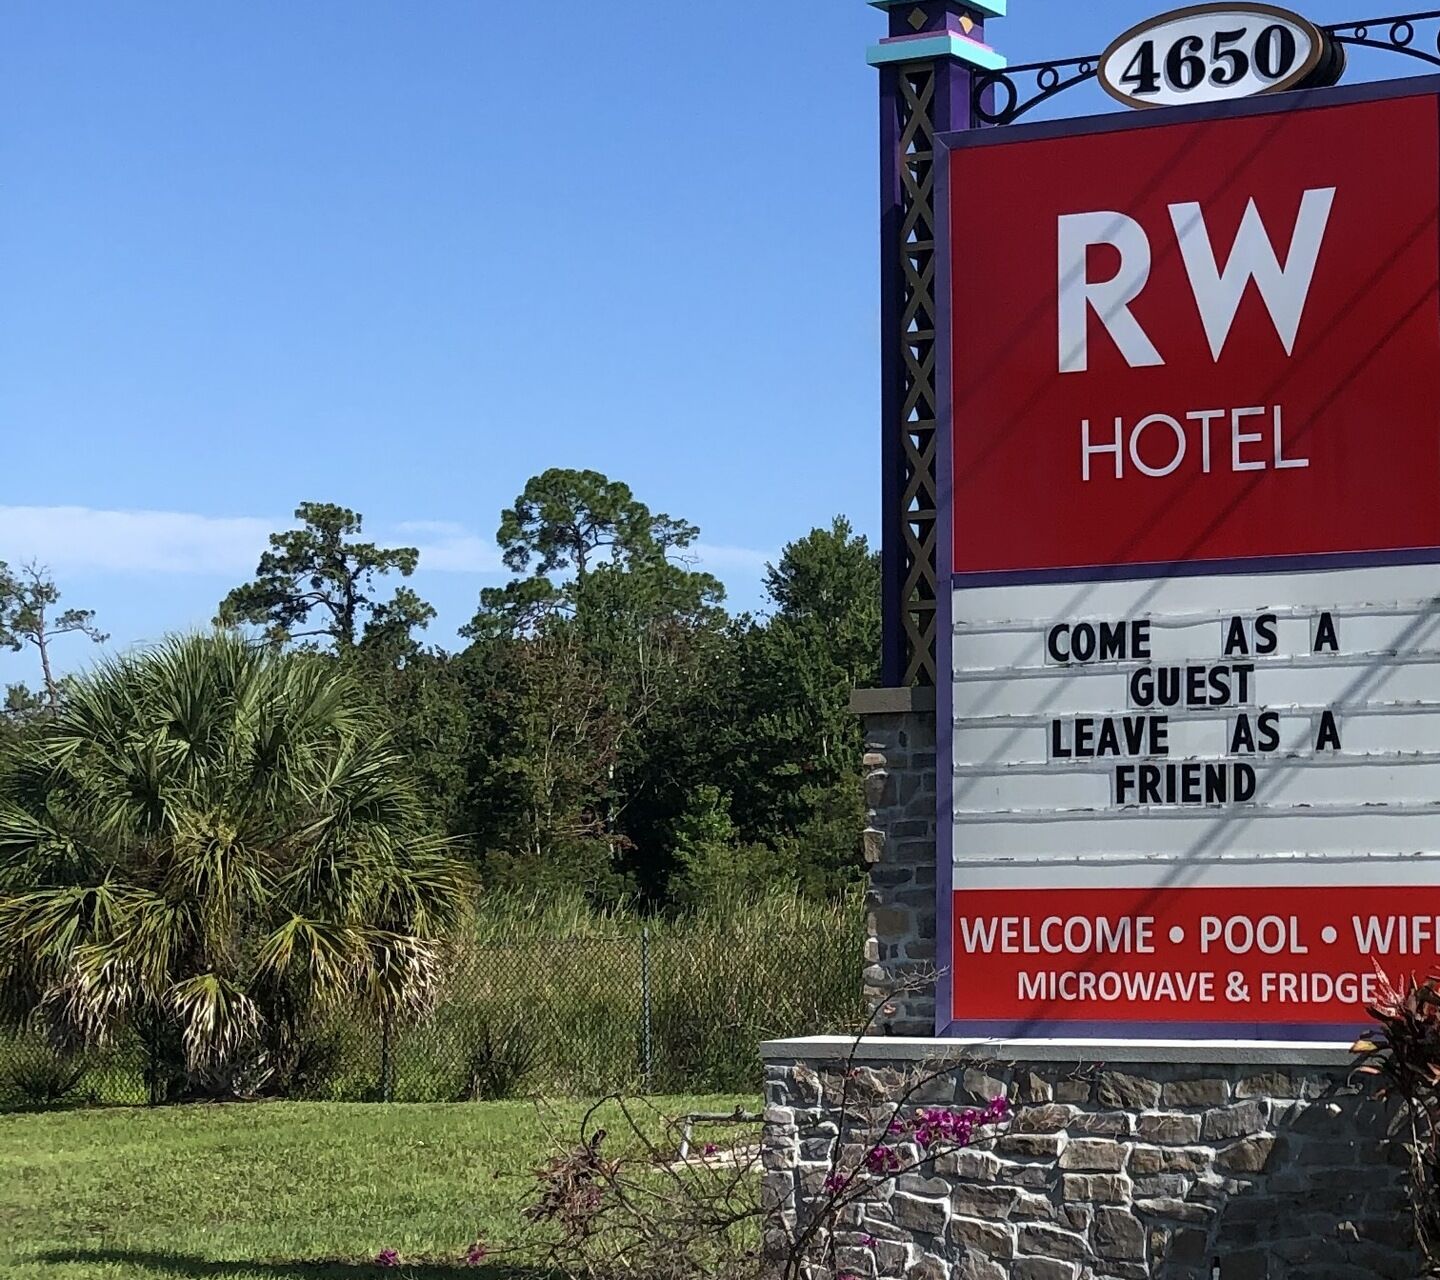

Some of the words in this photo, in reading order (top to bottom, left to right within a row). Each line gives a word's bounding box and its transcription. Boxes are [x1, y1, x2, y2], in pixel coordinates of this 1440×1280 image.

[1120, 24, 1296, 95] 4650
[1058, 186, 1337, 374] RW
[1081, 404, 1310, 481] HOTEL
[1047, 618, 1152, 663] COME
[1224, 613, 1278, 656] AS
[1313, 611, 1339, 652] A
[1130, 663, 1255, 707] GUEST
[1052, 715, 1169, 759] LEAVE
[1230, 711, 1280, 754] AS
[1315, 709, 1342, 751] A
[1115, 763, 1257, 805] FRIEND
[959, 914, 1155, 955] WELCOME
[1200, 914, 1308, 955] POOL
[1017, 970, 1214, 1004] MICROWAVE
[1226, 970, 1251, 1004] &
[1261, 971, 1378, 1004] FRIDGE
